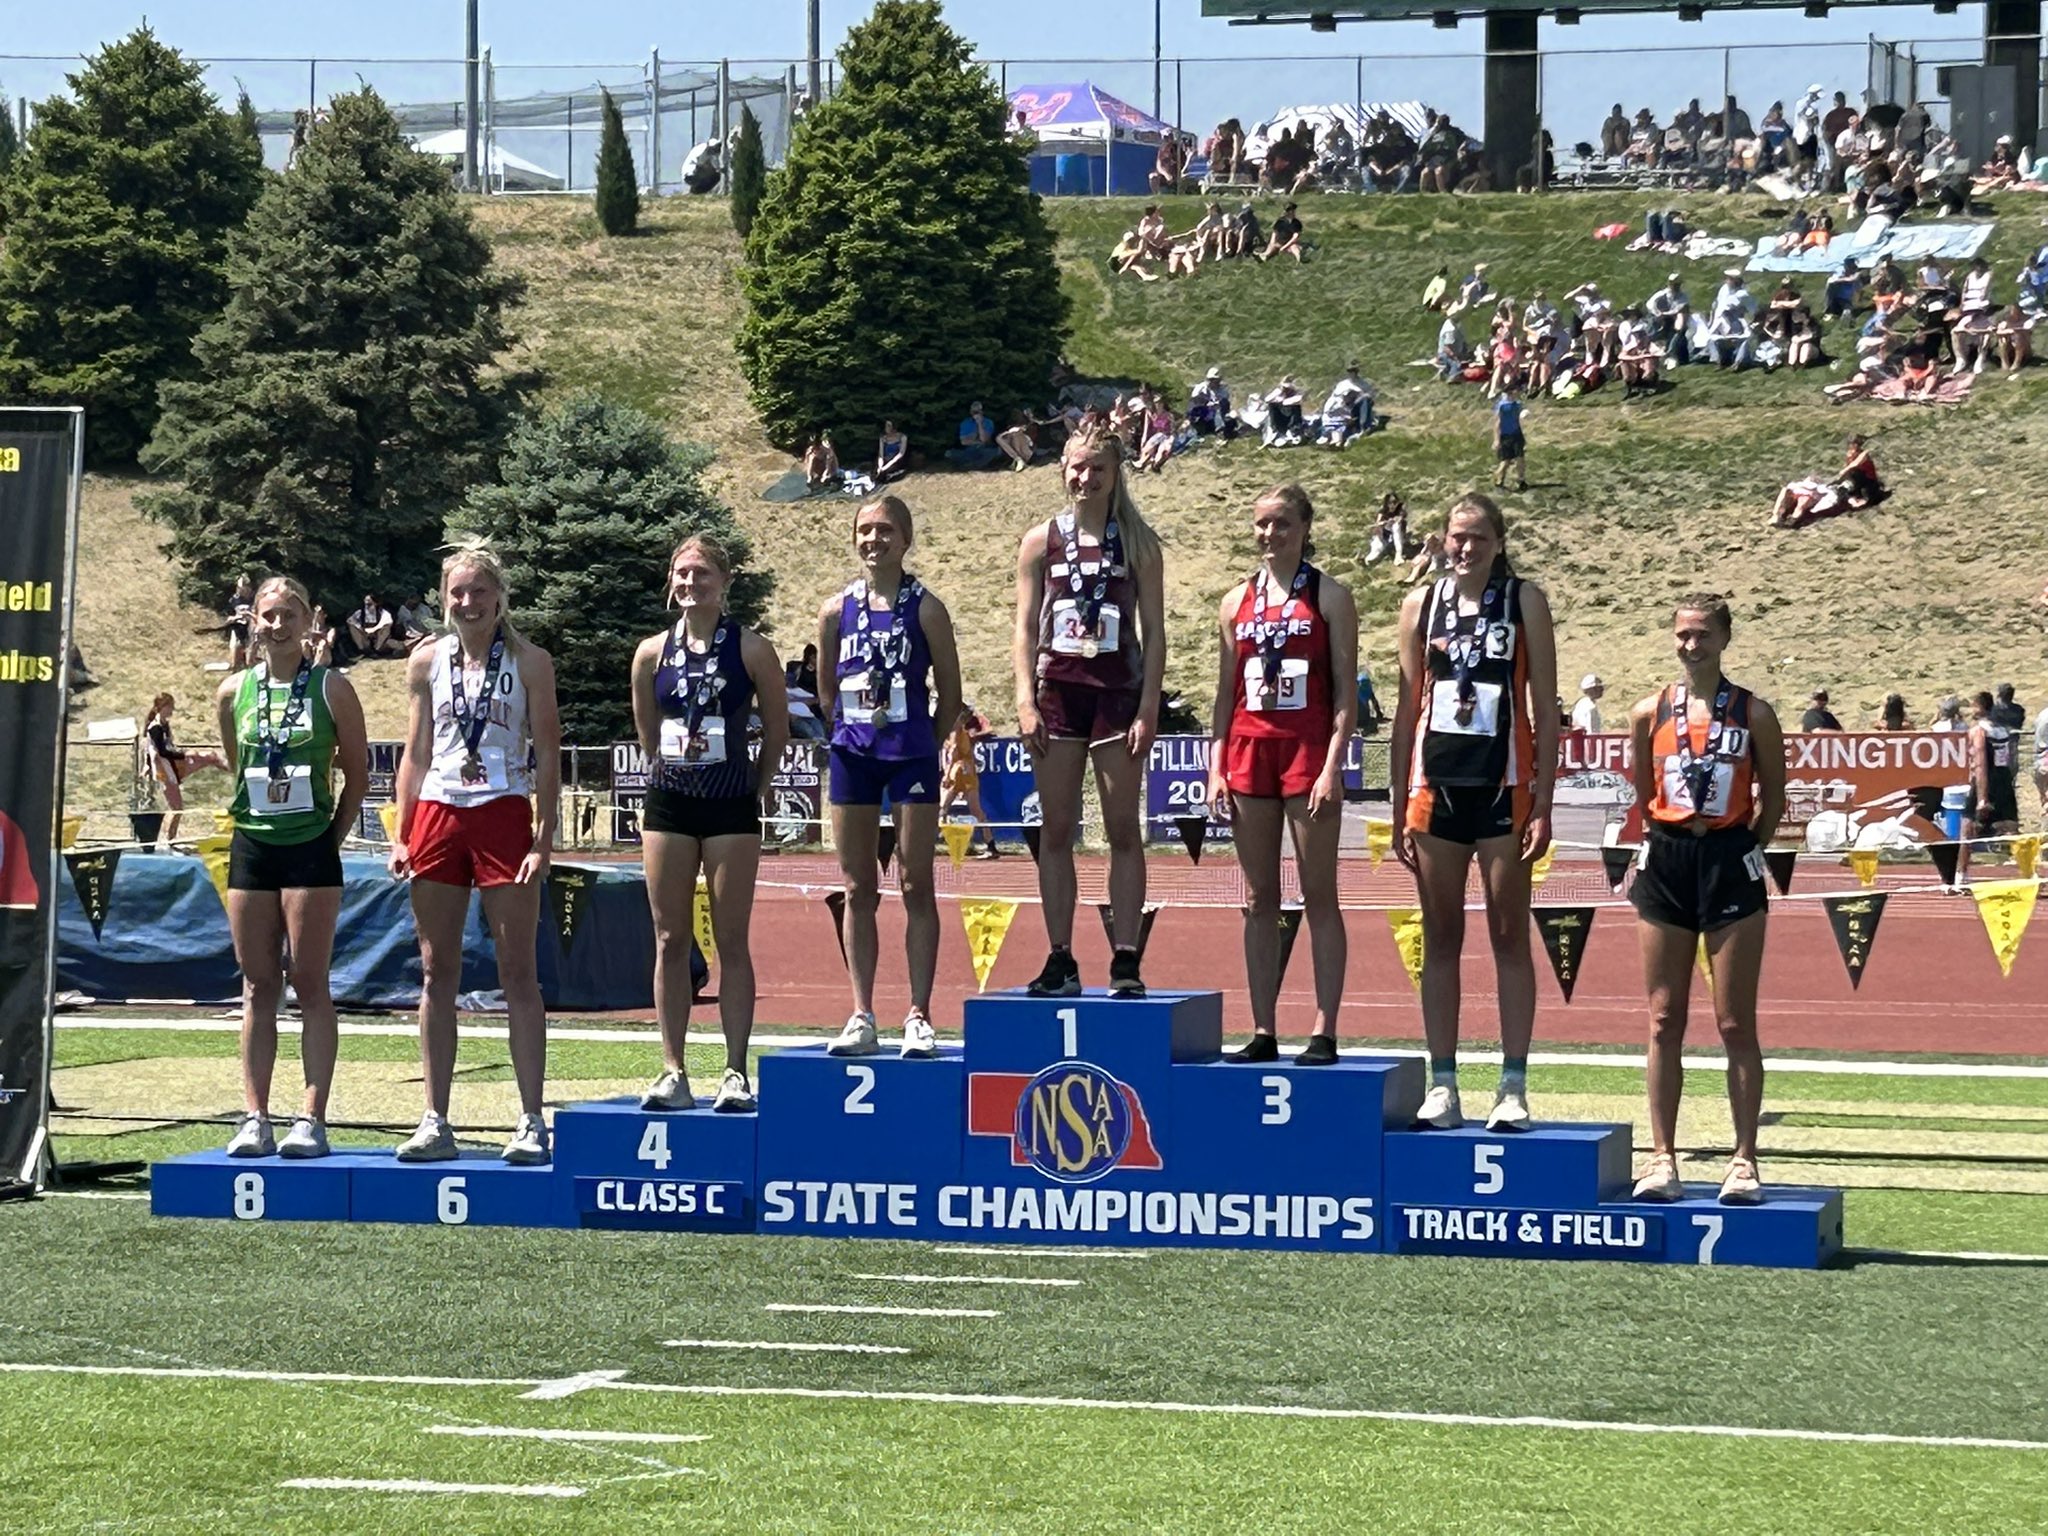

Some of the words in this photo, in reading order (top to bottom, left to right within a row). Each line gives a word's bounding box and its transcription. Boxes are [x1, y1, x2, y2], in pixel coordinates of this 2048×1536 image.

[1168, 780, 1206, 805] 20
[1056, 1008, 1078, 1058] 1
[844, 1065, 876, 1115] 2
[1260, 1075, 1293, 1126] 3
[637, 1121, 673, 1171] 4
[1473, 1143, 1505, 1195] 5
[233, 1172, 266, 1221] 8
[436, 1176, 469, 1226] 6
[596, 1180, 697, 1214] CLASS
[706, 1184, 726, 1215] C
[763, 1180, 919, 1228] STATE
[937, 1184, 1375, 1241] CHAMPIONSHIPS
[1402, 1207, 1509, 1243] TRACK
[1516, 1213, 1544, 1244] &
[1551, 1213, 1647, 1248] FIELD
[1691, 1214, 1724, 1265] 7
